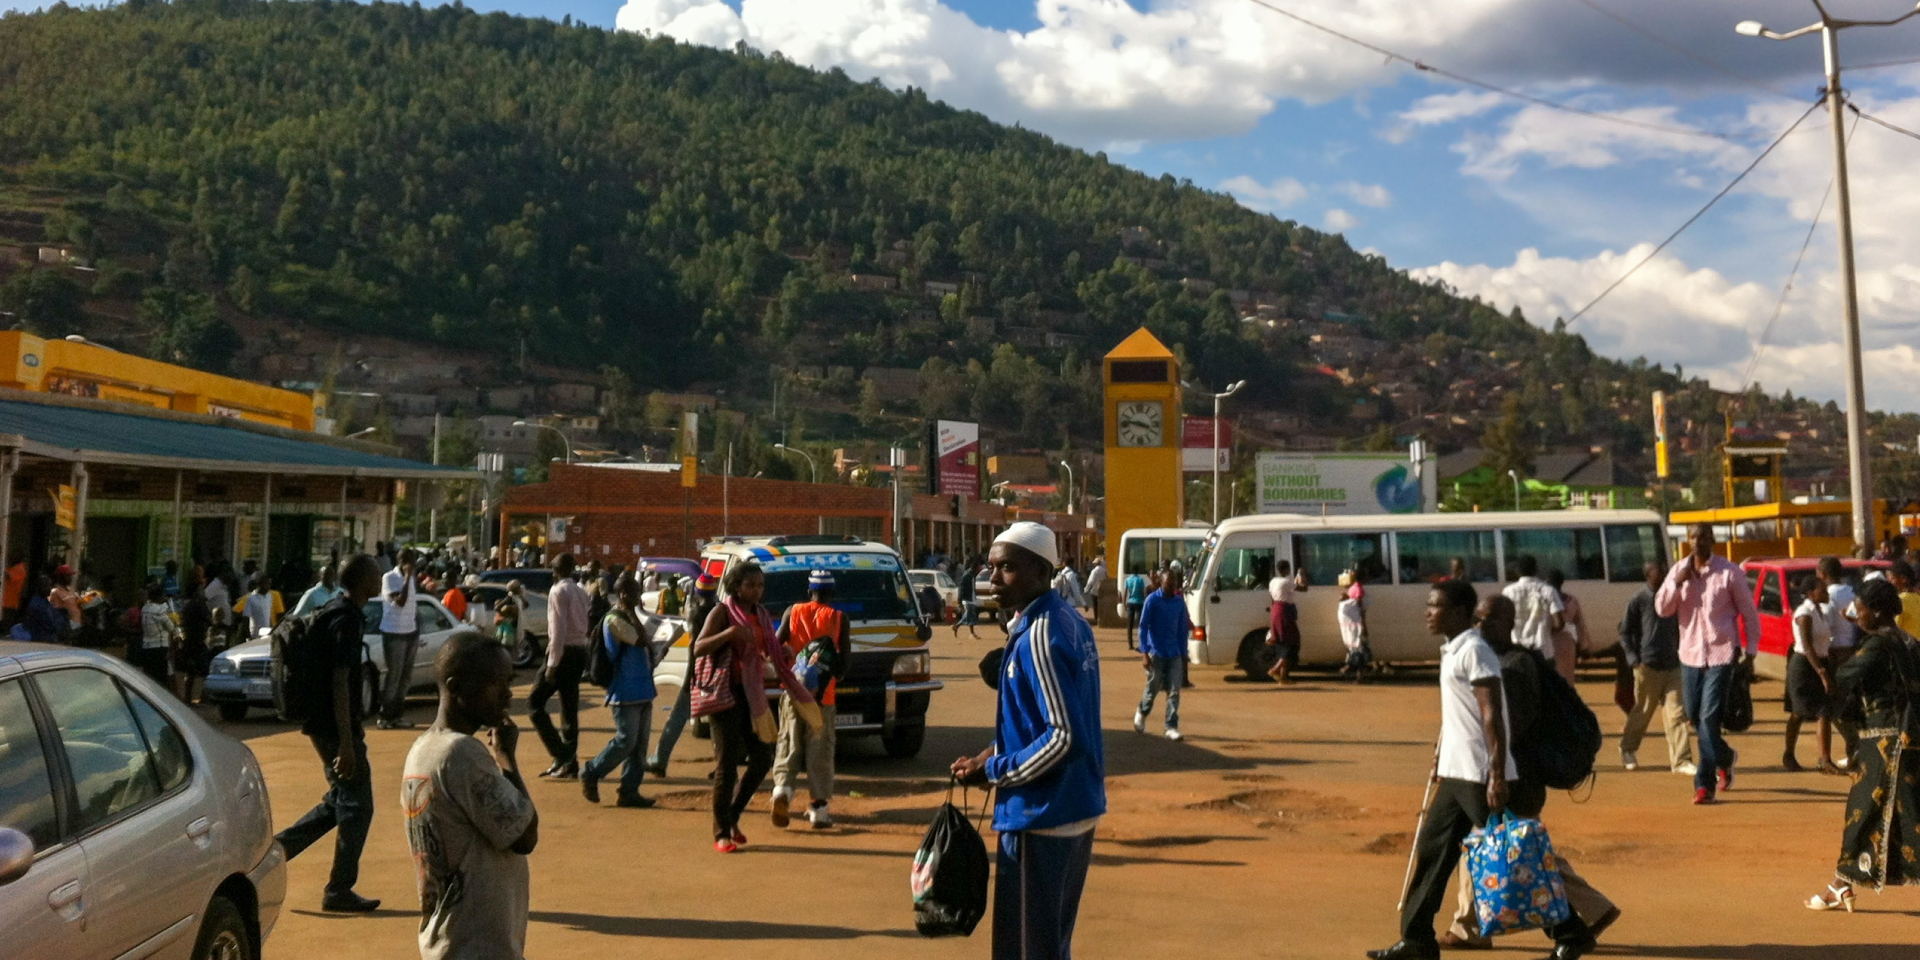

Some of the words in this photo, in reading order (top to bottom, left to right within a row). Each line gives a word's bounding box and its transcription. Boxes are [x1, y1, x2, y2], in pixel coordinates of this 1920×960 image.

[1263, 463, 1317, 473] BANKING
[1263, 474, 1321, 486] WITHOUT
[1263, 488, 1346, 500] BOUNDARIES
